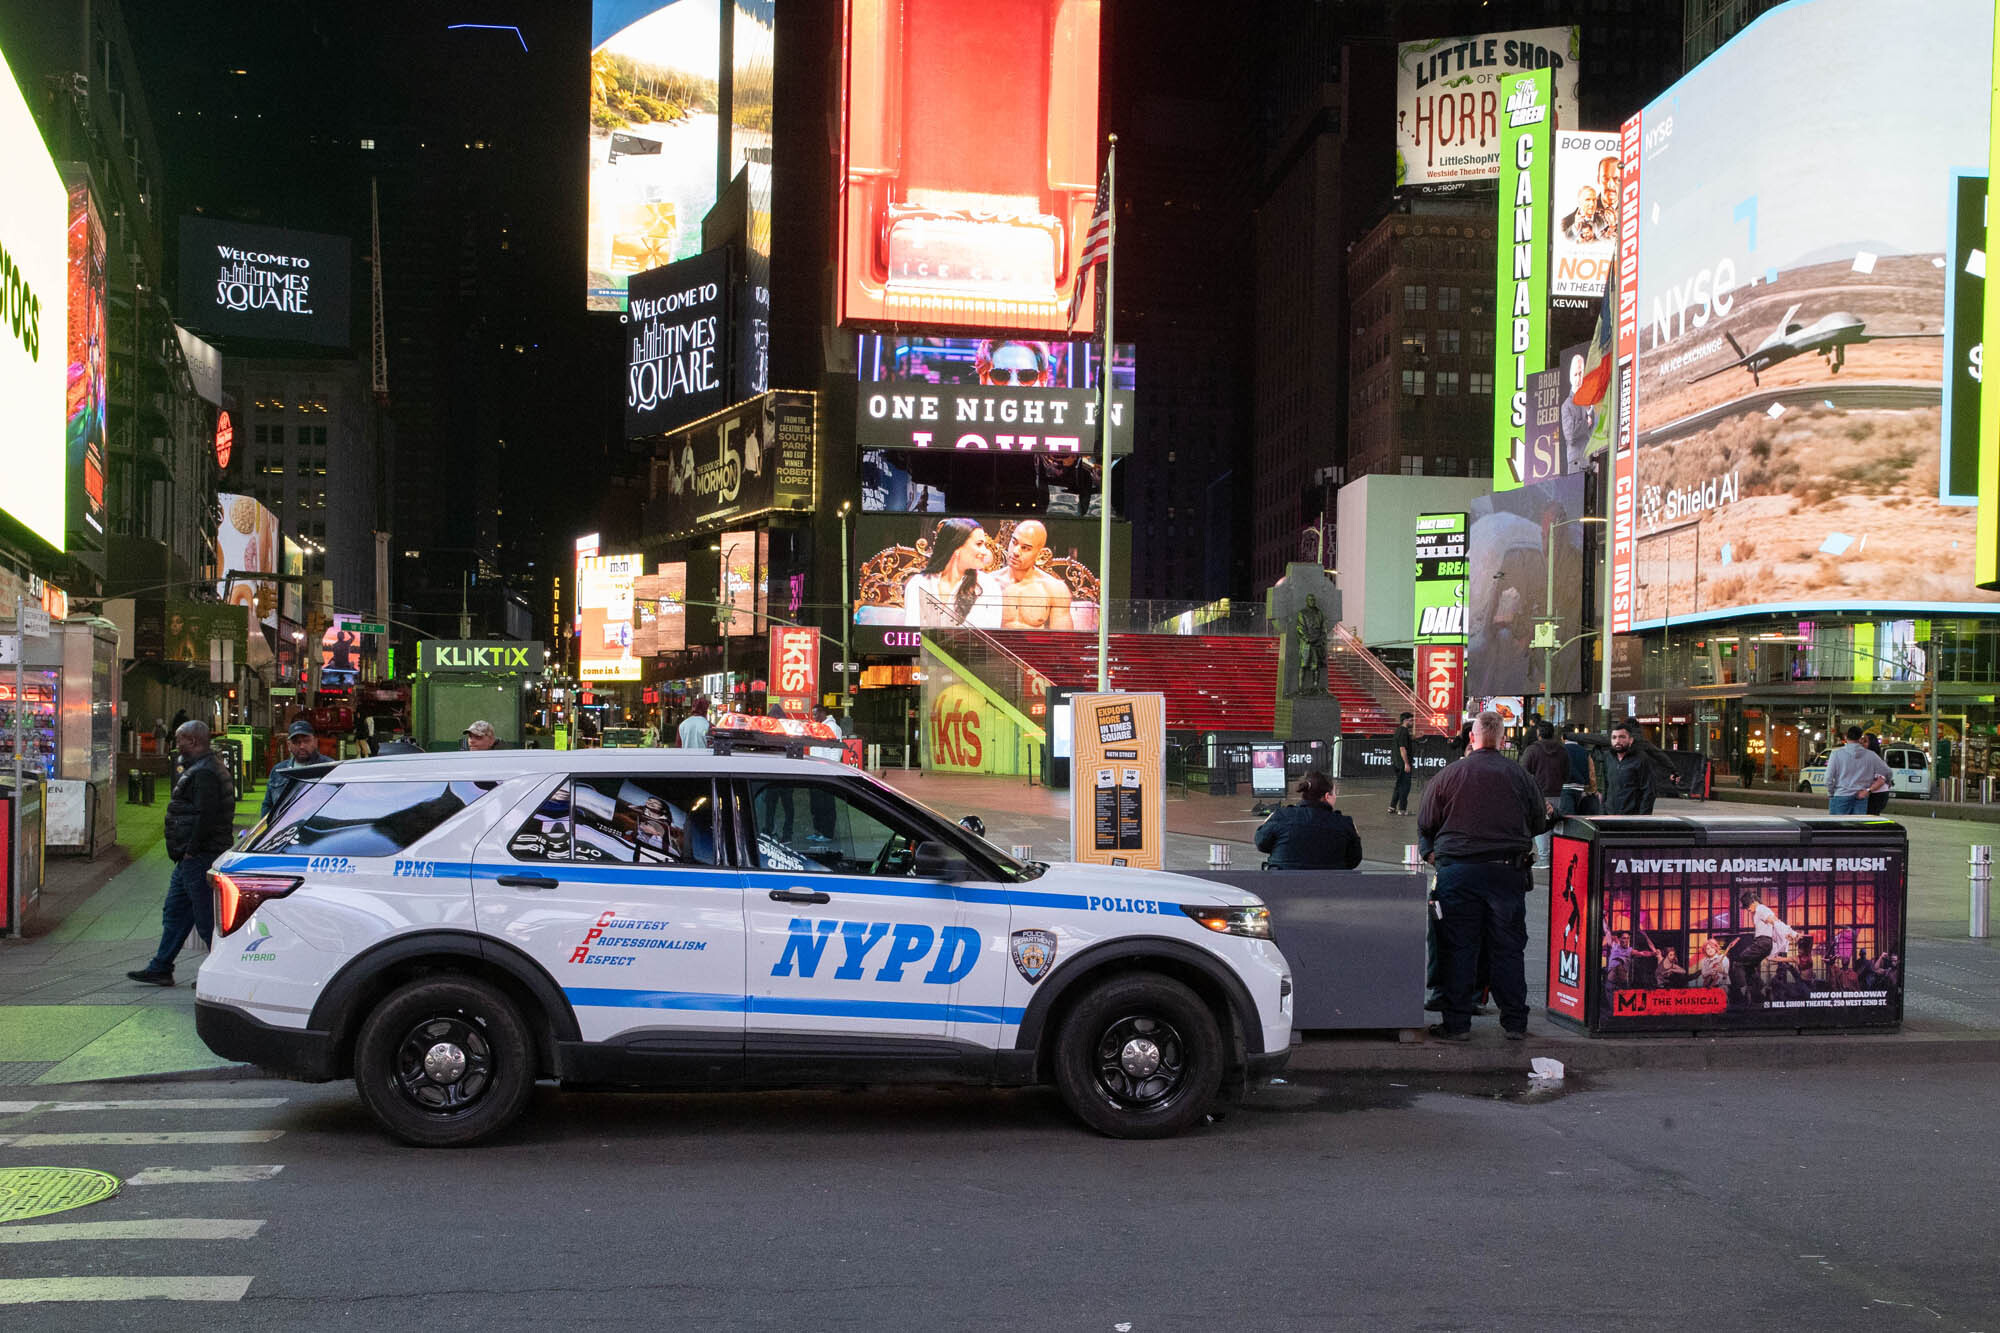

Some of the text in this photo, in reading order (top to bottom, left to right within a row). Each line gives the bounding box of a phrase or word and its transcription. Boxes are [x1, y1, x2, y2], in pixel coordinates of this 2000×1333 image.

[1417, 39, 1564, 90] LITTLE SHOP
[1477, 74, 1493, 84] OF
[1416, 91, 1497, 167] HORR
[1562, 138, 1591, 150] BOB
[1622, 116, 1640, 178] FREE
[1427, 168, 1458, 178] Westside
[1460, 166, 1486, 176] Theatre
[217, 246, 310, 268] WELCOME TO
[1620, 181, 1638, 340] CHOCOLATE
[258, 271, 310, 291] TIMES
[1511, 133, 1534, 427] CANNABIS
[1557, 282, 1567, 291] IN
[631, 283, 717, 321] WELCOME TO
[1552, 299, 1588, 308] KEVANI
[664, 316, 717, 354] TIMES
[869, 395, 939, 420] ONE
[956, 398, 1069, 425] NIGHT
[778, 432, 811, 441] SOUTH
[782, 441, 807, 450] PARK
[696, 463, 737, 496] MORMON
[776, 467, 812, 477] ROBERT
[780, 476, 809, 485] LOPEZ
[1666, 471, 1739, 519] Shield AI
[1615, 475, 1631, 555] COME
[436, 647, 529, 667] KLIKTIX
[782, 631, 812, 692] tkts
[583, 667, 604, 675] come
[605, 666, 614, 675] in
[1429, 650, 1456, 709] tkts
[1098, 705, 1131, 717] EXPLORE
[1099, 715, 1121, 725] MORE
[930, 695, 982, 767] tkts
[1100, 721, 1132, 734] IN TIMES
[1101, 730, 1132, 743] SQUARE
[1361, 751, 1393, 766] Time
[1412, 754, 1447, 768] quare
[48, 786, 63, 794] EN
[310, 857, 349, 873] 4032
[392, 860, 434, 878] PBMS
[1630, 858, 1717, 873] RIVETING
[1720, 857, 1833, 873] ADRENALINE
[1088, 896, 1159, 914] POLICE
[596, 911, 670, 931] COURTESY
[582, 928, 708, 950] PROFESSIONALISM
[1022, 930, 1046, 938] POLICE
[241, 953, 276, 961] HYBRID
[568, 946, 636, 966] RESPECT
[770, 918, 982, 985] NYPD
[1560, 949, 1578, 980] MJ
[1618, 992, 1719, 1012] MJ THE MUSICAL
[1810, 991, 1829, 999] NOW
[1843, 990, 1887, 998] BROADWAY
[1786, 1000, 1805, 1008] SIMON
